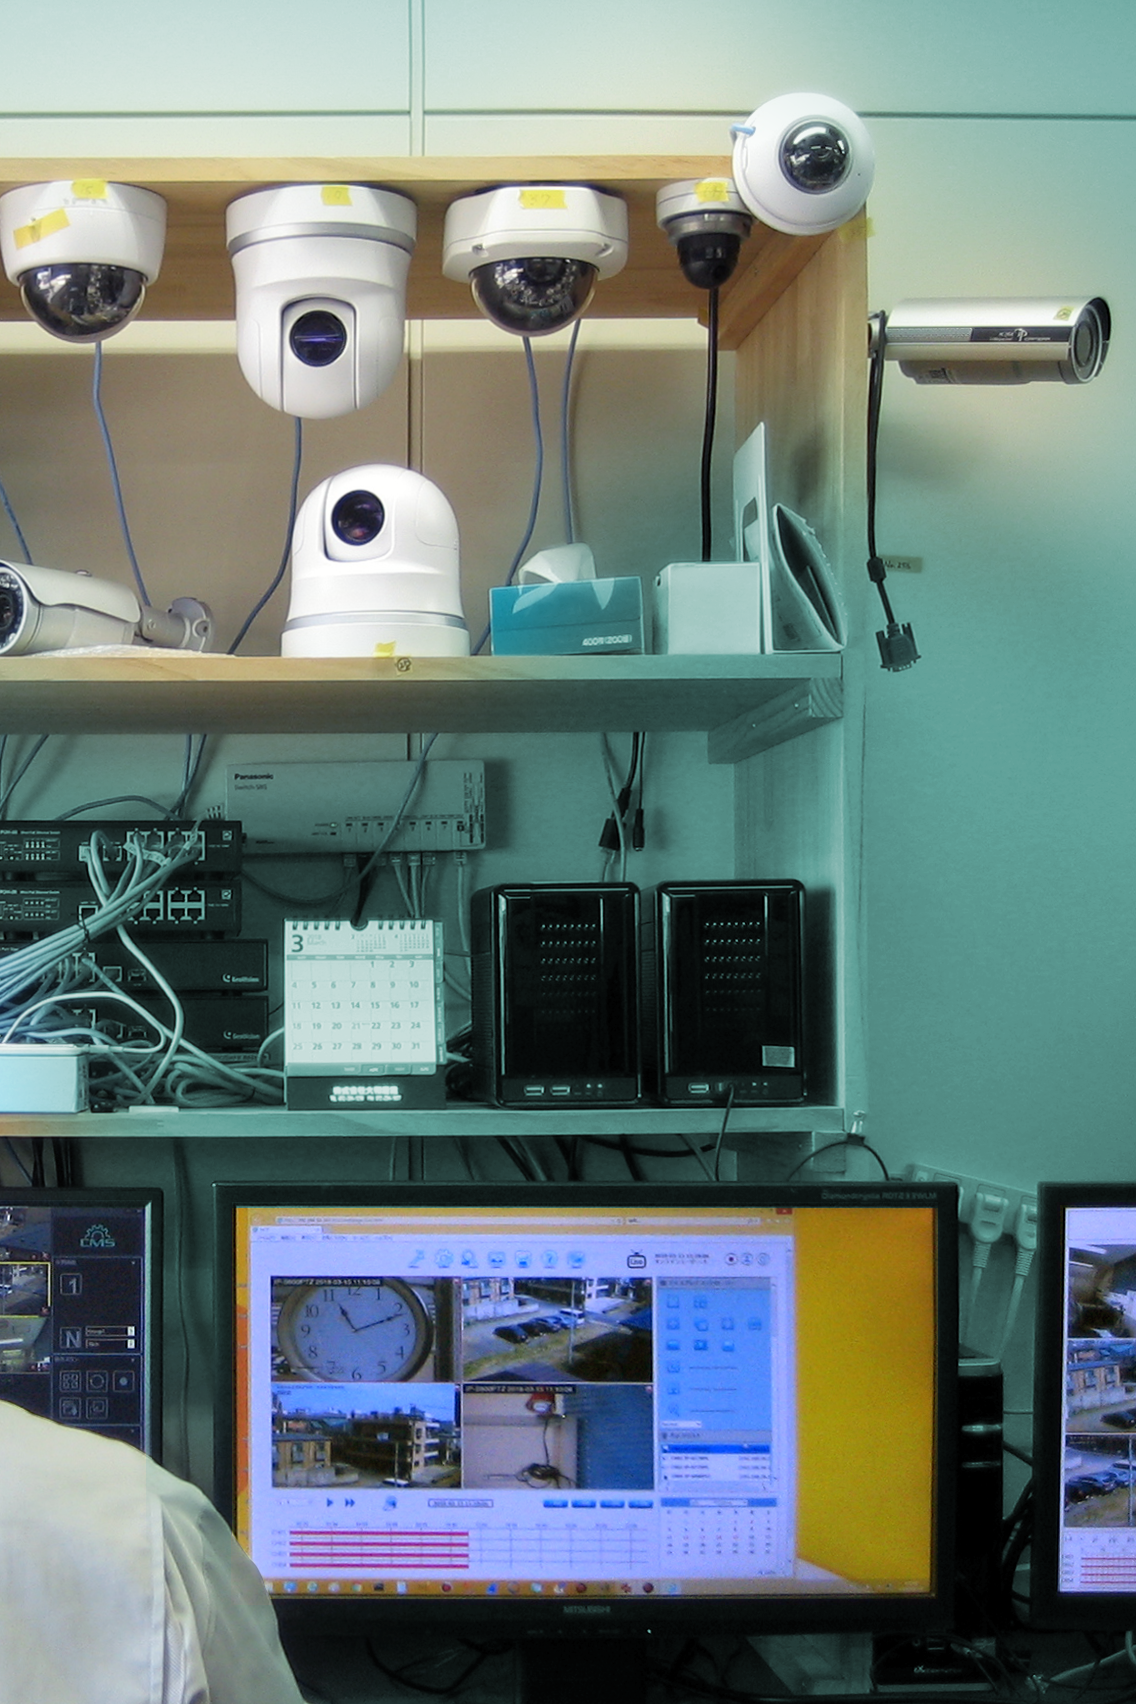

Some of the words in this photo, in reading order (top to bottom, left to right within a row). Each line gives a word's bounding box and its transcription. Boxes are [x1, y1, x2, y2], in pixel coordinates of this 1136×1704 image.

[291, 934, 304, 953] 3
[331, 981, 336, 989] 6
[80, 1238, 115, 1248] CMS
[68, 1277, 77, 1294] 1
[347, 1287, 361, 1296] 12
[323, 1289, 334, 1301] 11
[376, 1287, 381, 1300] 1
[305, 1305, 319, 1318] 10
[393, 1302, 403, 1312] 2
[301, 1324, 311, 1337] 9
[403, 1323, 410, 1337] 3
[65, 1330, 81, 1348] N
[308, 1346, 318, 1359] 8
[395, 1346, 404, 1359] 4
[326, 1362, 336, 1375] 7
[351, 1368, 362, 1381] 6
[377, 1362, 387, 1374] 5
